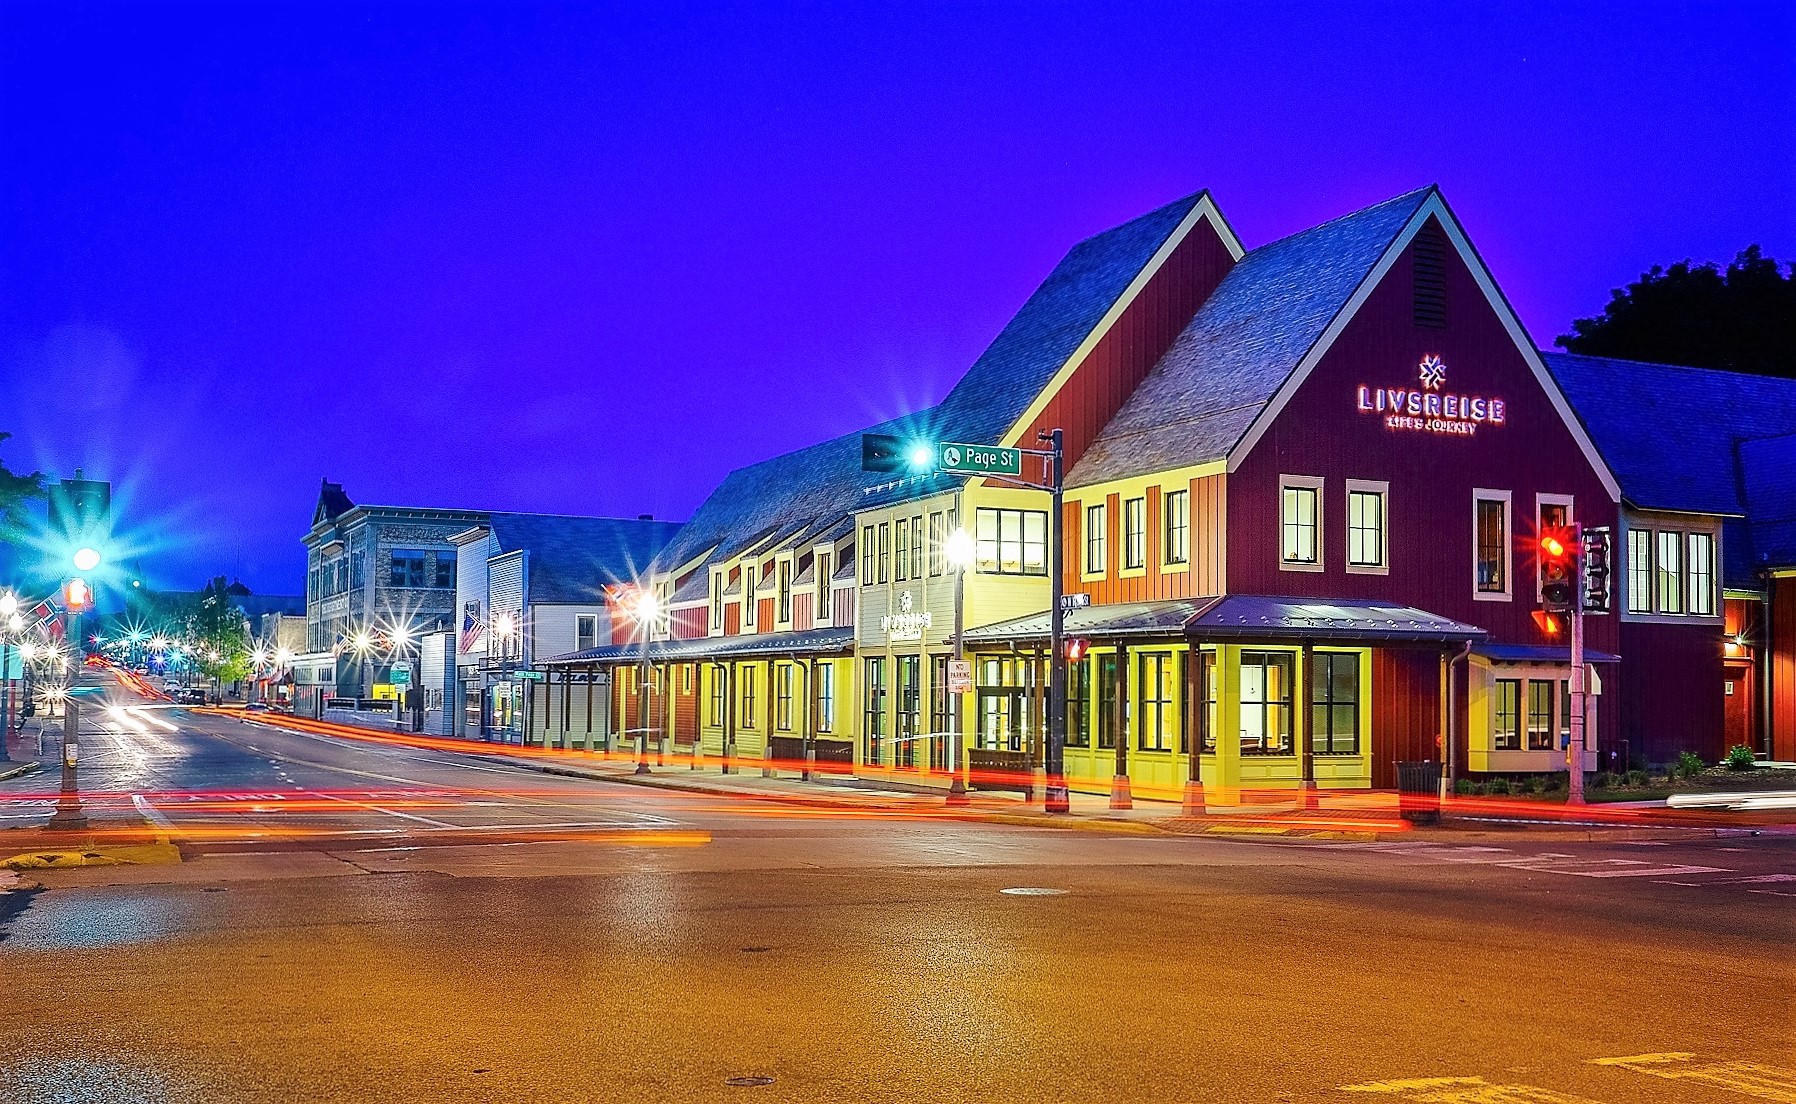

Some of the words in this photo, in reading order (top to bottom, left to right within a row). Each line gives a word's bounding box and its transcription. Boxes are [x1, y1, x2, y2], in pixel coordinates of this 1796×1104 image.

[1358, 386, 1505, 422] LIVSREISE
[1425, 419, 1477, 434] JOURNEY
[966, 448, 997, 469] Page
[1000, 451, 1014, 467] St
